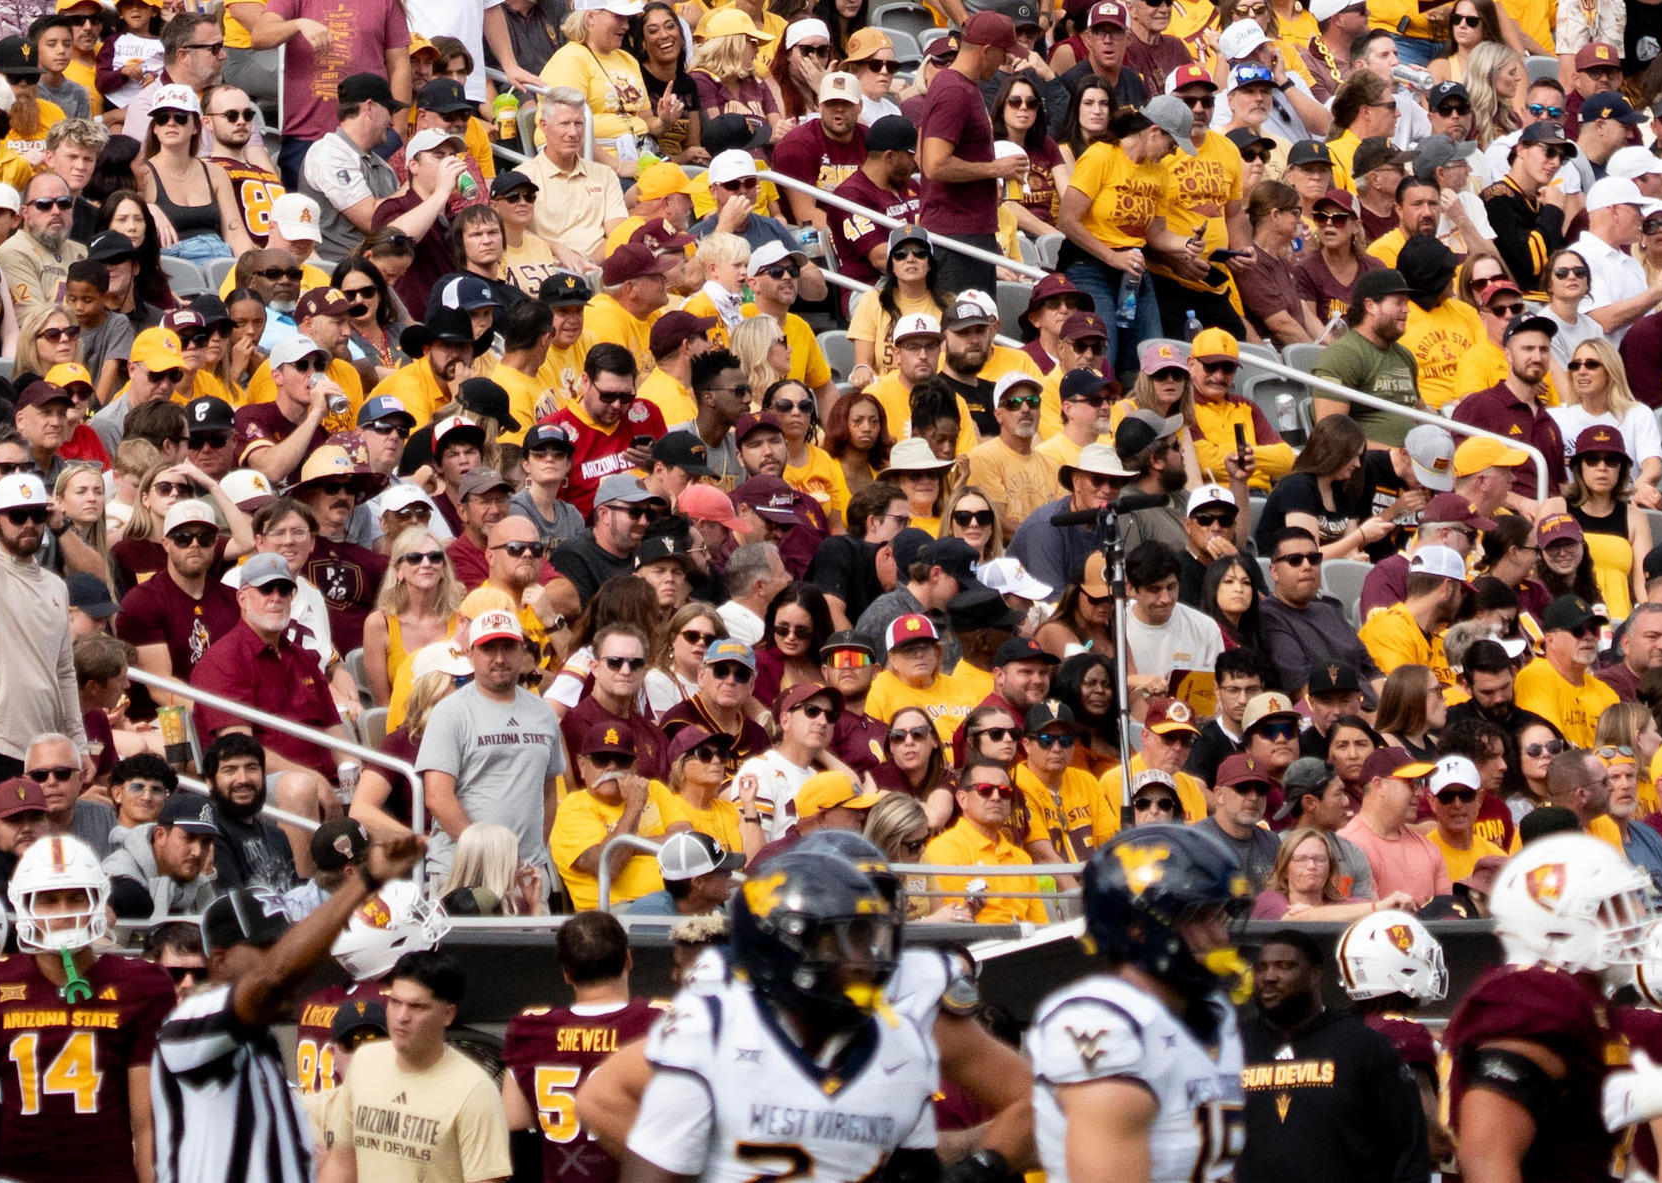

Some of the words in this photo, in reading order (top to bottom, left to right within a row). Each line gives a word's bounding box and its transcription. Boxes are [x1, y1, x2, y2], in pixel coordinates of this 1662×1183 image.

[842, 214, 876, 243] 42
[481, 613, 512, 628] RAINIER
[477, 733, 520, 748] ARIZONA
[3, 1010, 67, 1030] ARIZONA
[71, 1009, 120, 1030] STATE
[557, 1027, 619, 1052] SHEWELL
[8, 1031, 103, 1115] 14
[1241, 1063, 1275, 1089] SUN
[1276, 1061, 1335, 1088] DEVILS
[355, 1104, 399, 1133] ARIZONA
[400, 1114, 440, 1147] STATE
[749, 1103, 806, 1135] WEST
[354, 1136, 382, 1153] SUN
[382, 1139, 431, 1162] DEVILS
